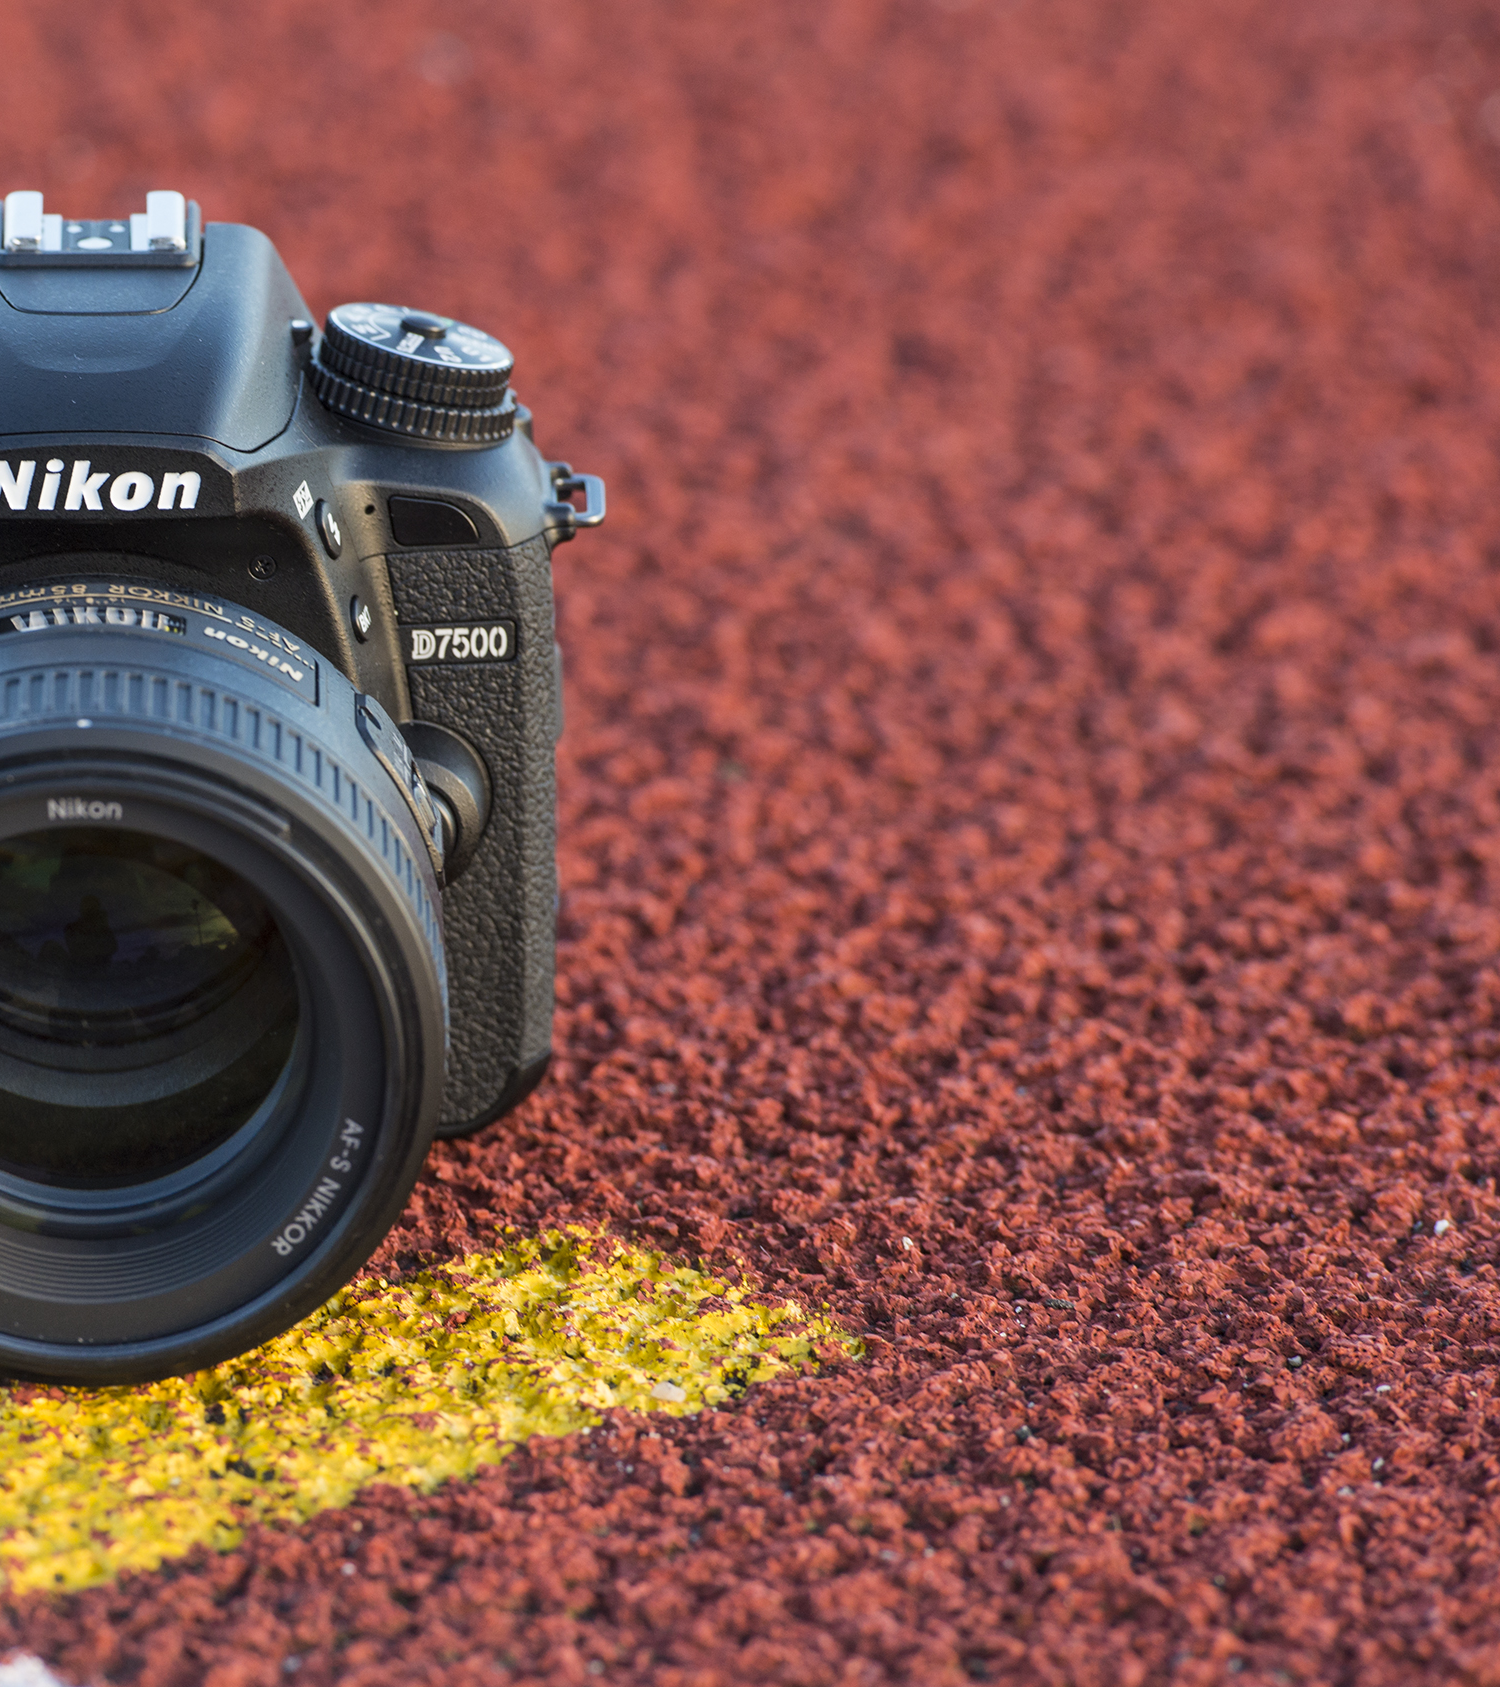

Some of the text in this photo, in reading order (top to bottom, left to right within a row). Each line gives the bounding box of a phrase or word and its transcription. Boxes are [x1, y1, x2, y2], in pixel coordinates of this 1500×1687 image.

[108, 584, 224, 616] NIKKOR
[241, 615, 301, 653] AF-S
[411, 625, 508, 660] D7500
[203, 626, 304, 683] Nikon
[47, 797, 123, 820] Nikon
[270, 1117, 364, 1256] AF-S NIKKOR
